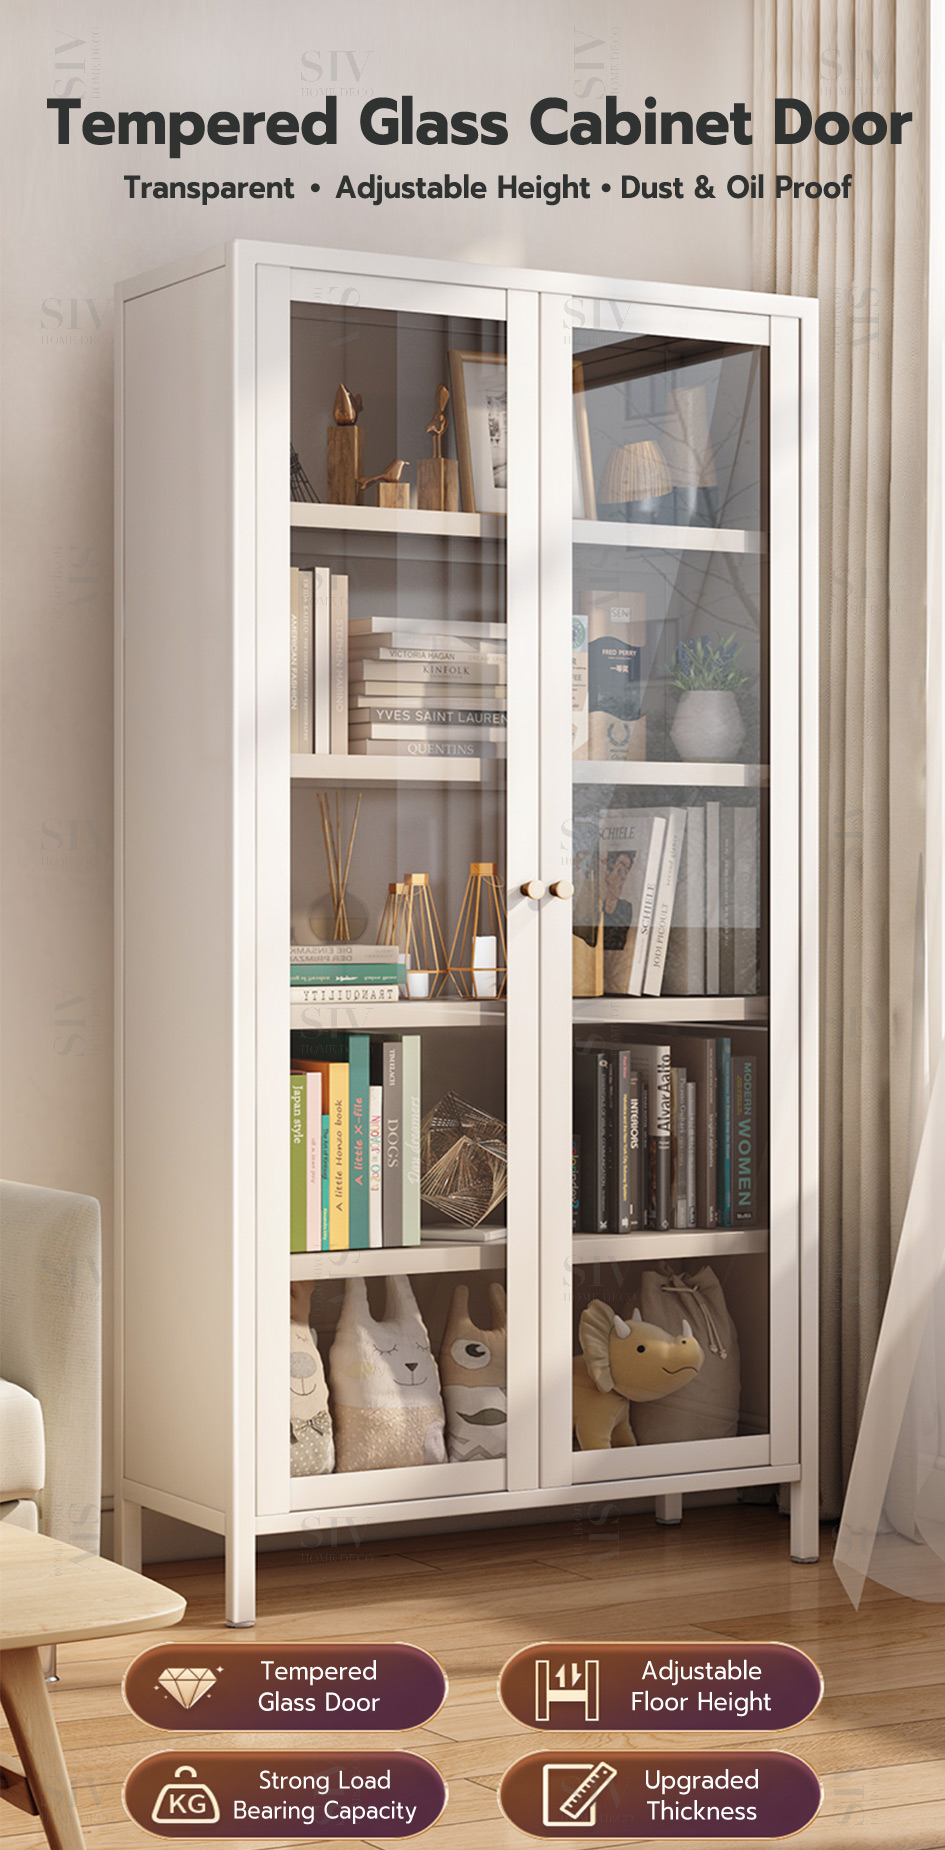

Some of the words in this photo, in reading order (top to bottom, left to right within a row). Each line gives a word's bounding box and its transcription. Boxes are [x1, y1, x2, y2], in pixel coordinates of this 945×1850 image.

[390, 650, 426, 659] VICTORIA
[428, 652, 455, 660] HAGAN
[618, 649, 637, 657] PERRY
[423, 665, 470, 675] KINFOLK
[335, 673, 343, 712] MARINO
[376, 709, 410, 721] YVES
[415, 710, 453, 722] SAINT
[407, 743, 474, 755] QUENTINS
[641, 883, 655, 934] SCHIELE
[292, 1085, 303, 1117] Japan
[353, 1097, 363, 1136] X-file
[631, 1099, 639, 1149] INTERIORS
[292, 1119, 303, 1144] style
[387, 1119, 398, 1167] DOGS
[353, 1139, 363, 1170] little
[738, 1119, 751, 1206] WOMEN
[354, 1175, 363, 1186] A
[336, 1202, 343, 1212] A
